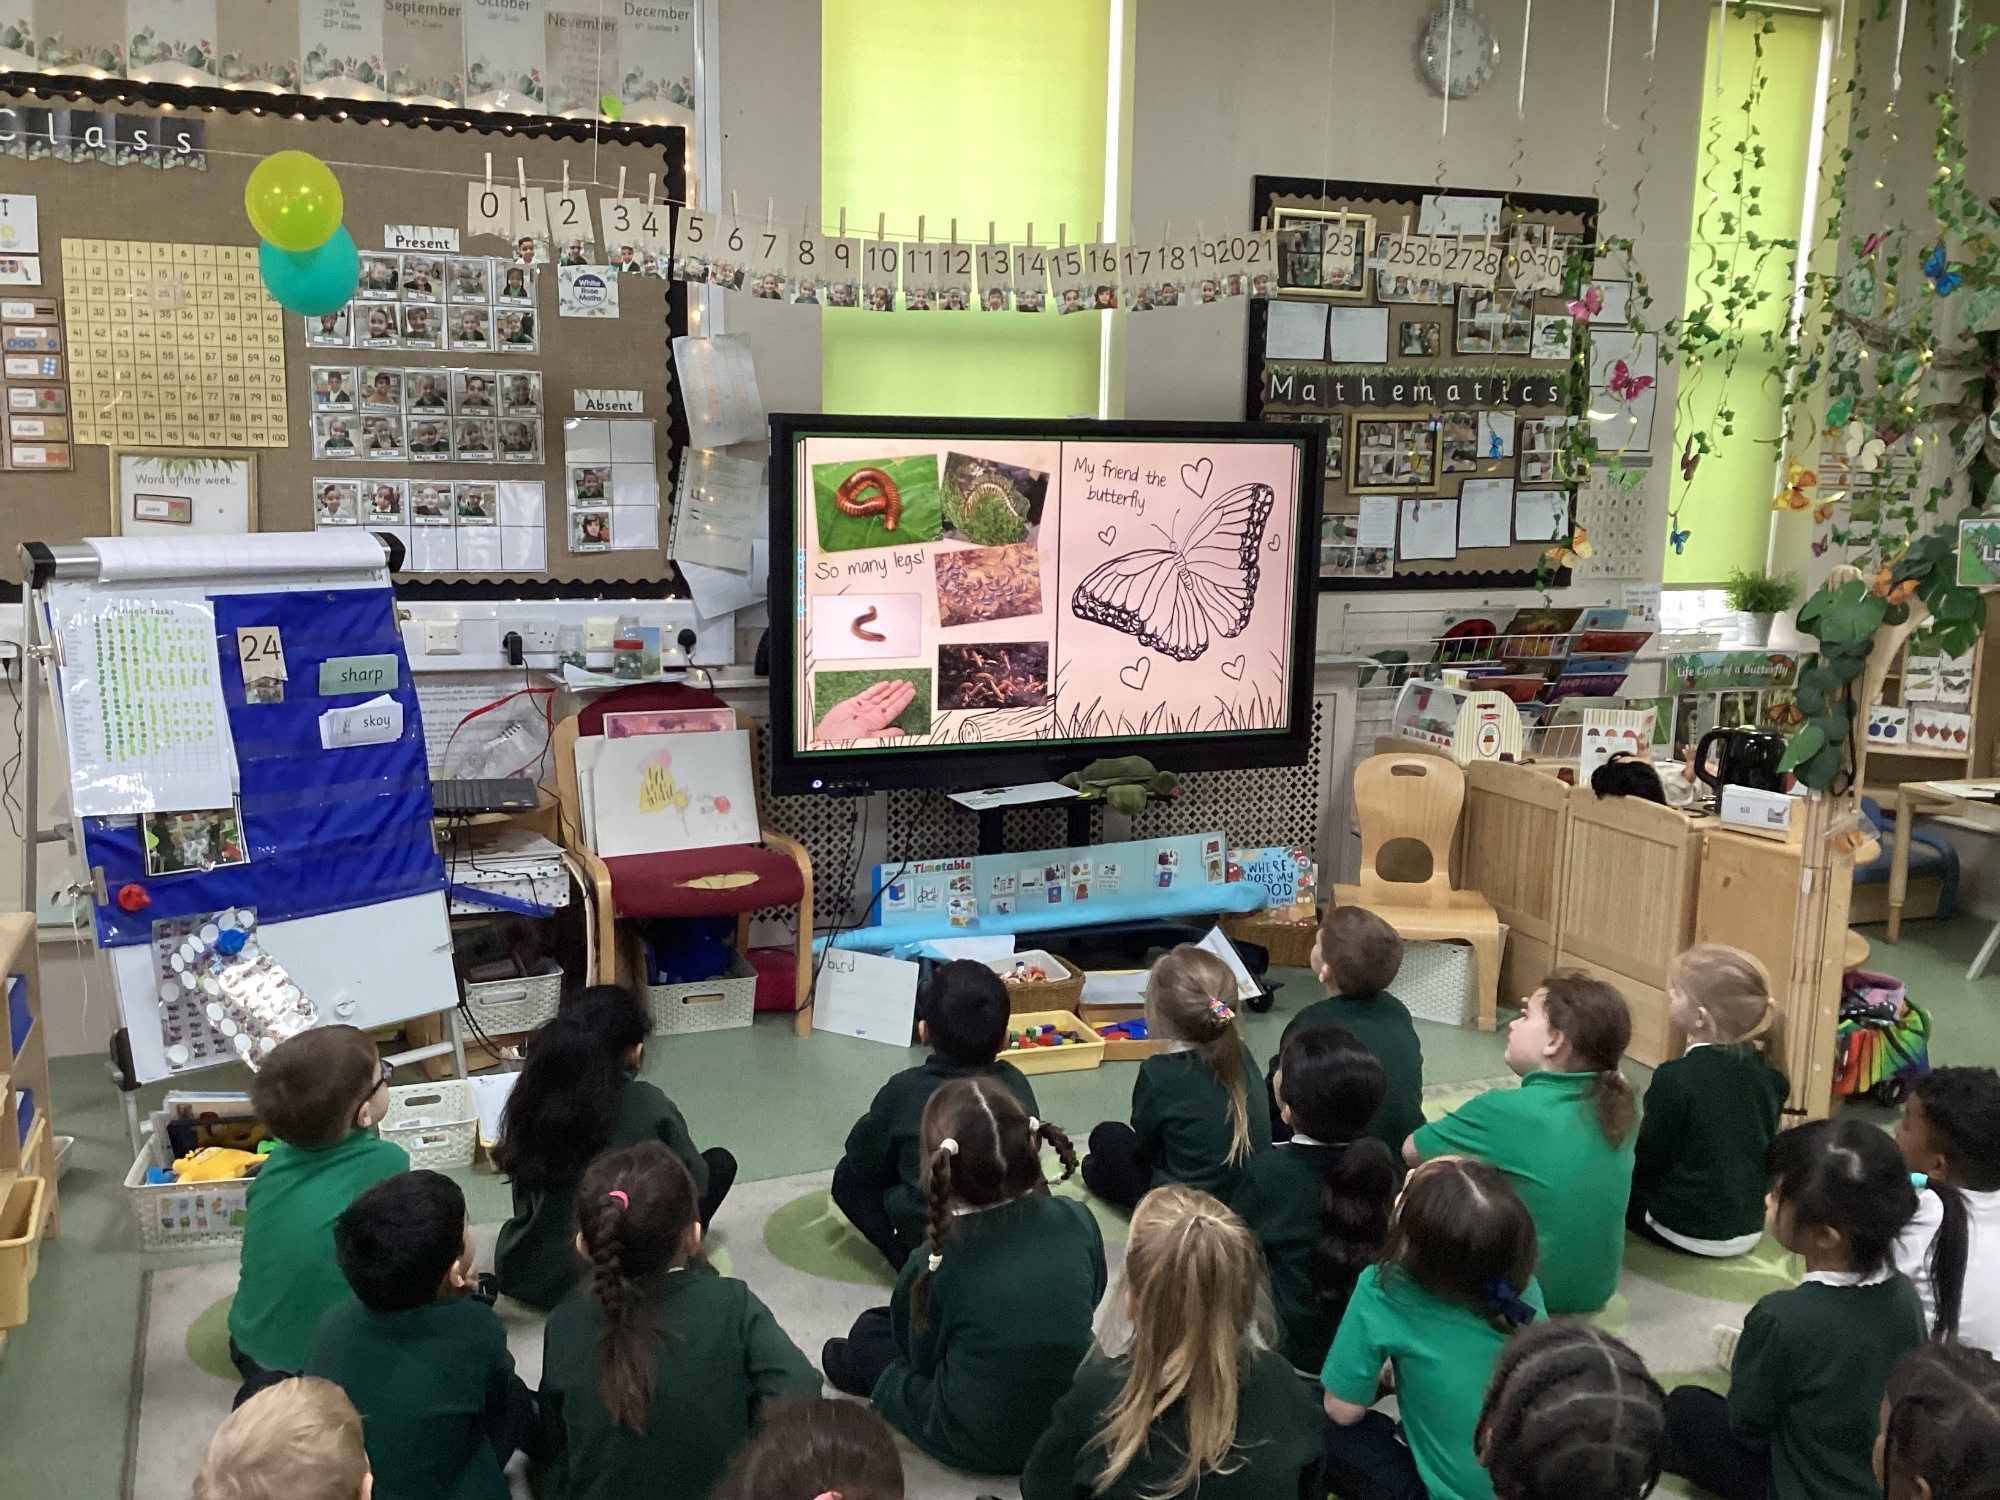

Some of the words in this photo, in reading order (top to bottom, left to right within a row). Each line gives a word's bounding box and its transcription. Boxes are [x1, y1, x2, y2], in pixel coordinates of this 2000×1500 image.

[385, 0, 461, 18] September
[624, 1, 690, 20] December
[548, 12, 617, 31] November
[0, 109, 191, 153] Class
[395, 235, 450, 250] Present
[480, 192, 499, 218] 0
[520, 197, 530, 222] 1
[560, 198, 578, 225] 2
[614, 205, 631, 232] 3
[642, 211, 658, 237] 4
[687, 217, 704, 243] 5
[728, 227, 743, 251] 6
[763, 234, 777, 258] 7
[799, 240, 814, 265] 8
[834, 244, 849, 268] 9
[868, 248, 897, 273] 10
[907, 249, 933, 274] 11
[943, 249, 970, 275] 12
[981, 250, 1009, 275] 13
[1018, 252, 1046, 276] 14
[1052, 251, 1081, 278] 15
[1088, 248, 1116, 273] 16
[1125, 251, 1151, 275] 17
[1159, 246, 1185, 271] 18
[1190, 242, 1217, 268] 19
[1218, 237, 1245, 264] 20
[1246, 238, 1273, 263] 21
[1326, 233, 1354, 257] 23
[1390, 240, 1415, 265] 25
[1417, 243, 1441, 267] 26
[1446, 248, 1473, 272] 27
[1473, 248, 1497, 275] 28
[1512, 249, 1537, 280] 29
[1538, 254, 1561, 277] 30
[92, 245, 98, 253] 2
[114, 246, 120, 254] 3
[136, 247, 142, 255] 4
[159, 248, 164, 256] 5
[181, 249, 187, 257] 6
[203, 250, 208, 258] 7
[224, 251, 230, 259] 8
[245, 252, 251, 260] 9
[71, 266, 77, 275] 11
[92, 266, 102, 276] 12
[114, 268, 124, 276] 13
[137, 268, 146, 277] 14
[202, 271, 211, 280] 17
[224, 273, 232, 281] 18
[246, 274, 254, 282] 19
[578, 278, 601, 287] White
[578, 294, 602, 302] Maths
[581, 287, 599, 295] Rose
[71, 306, 80, 315] 31
[93, 307, 105, 316] 32
[115, 308, 127, 317] 33
[138, 309, 149, 318] 34
[182, 310, 193, 319] 36
[203, 311, 214, 320] 37
[225, 312, 236, 321] 38
[246, 313, 257, 321] 39
[266, 314, 278, 322] 40
[73, 328, 82, 337] 41
[94, 329, 106, 337] 42
[116, 330, 128, 338] 43
[138, 330, 150, 338] 44
[160, 331, 172, 340] 45
[182, 332, 194, 340] 46
[204, 332, 215, 340] 47
[226, 333, 237, 342] 48
[247, 334, 258, 342] 49
[268, 334, 279, 343] 50
[74, 348, 83, 357] 51
[96, 349, 107, 358] 52
[118, 350, 129, 358] 53
[140, 350, 151, 359] 54
[162, 351, 174, 359] 55
[184, 352, 195, 360] 56
[205, 352, 216, 360] 57
[227, 353, 238, 362] 58
[248, 354, 259, 362] 59
[269, 354, 280, 363] 60
[1270, 374, 1559, 402] Mathematics
[585, 399, 633, 411] Absent
[100, 430, 112, 439] 92
[123, 431, 134, 440] 93
[144, 431, 156, 439] 94
[166, 431, 178, 440] 95
[188, 431, 200, 440] 96
[210, 432, 221, 440] 97
[231, 432, 242, 441] 98
[252, 433, 264, 441] 99
[272, 434, 286, 442] 100
[1074, 457, 1095, 482] My
[1102, 459, 1140, 483] friend
[1146, 470, 1167, 487] the
[136, 474, 165, 485] Word
[169, 475, 180, 487] of
[184, 475, 201, 485] the
[1087, 485, 1145, 516] butterfly
[815, 562, 840, 580] So
[848, 558, 888, 578] many
[894, 548, 926, 575] legs!
[150, 607, 174, 616] Tasks
[241, 634, 281, 662] 24
[341, 667, 383, 685] sharp
[1677, 665, 1694, 678] Life
[1696, 665, 1721, 678] Cycle
[1724, 664, 1733, 676] of
[1743, 664, 1788, 677] Butterfly
[363, 714, 391, 729] skoy
[1740, 806, 1751, 814] till
[913, 859, 972, 874] Timetable
[1248, 860, 1287, 873] WHERE
[1247, 873, 1273, 883] DOES
[1277, 871, 1294, 883] MY
[1264, 883, 1292, 896] OD
[827, 952, 855, 973] bird
